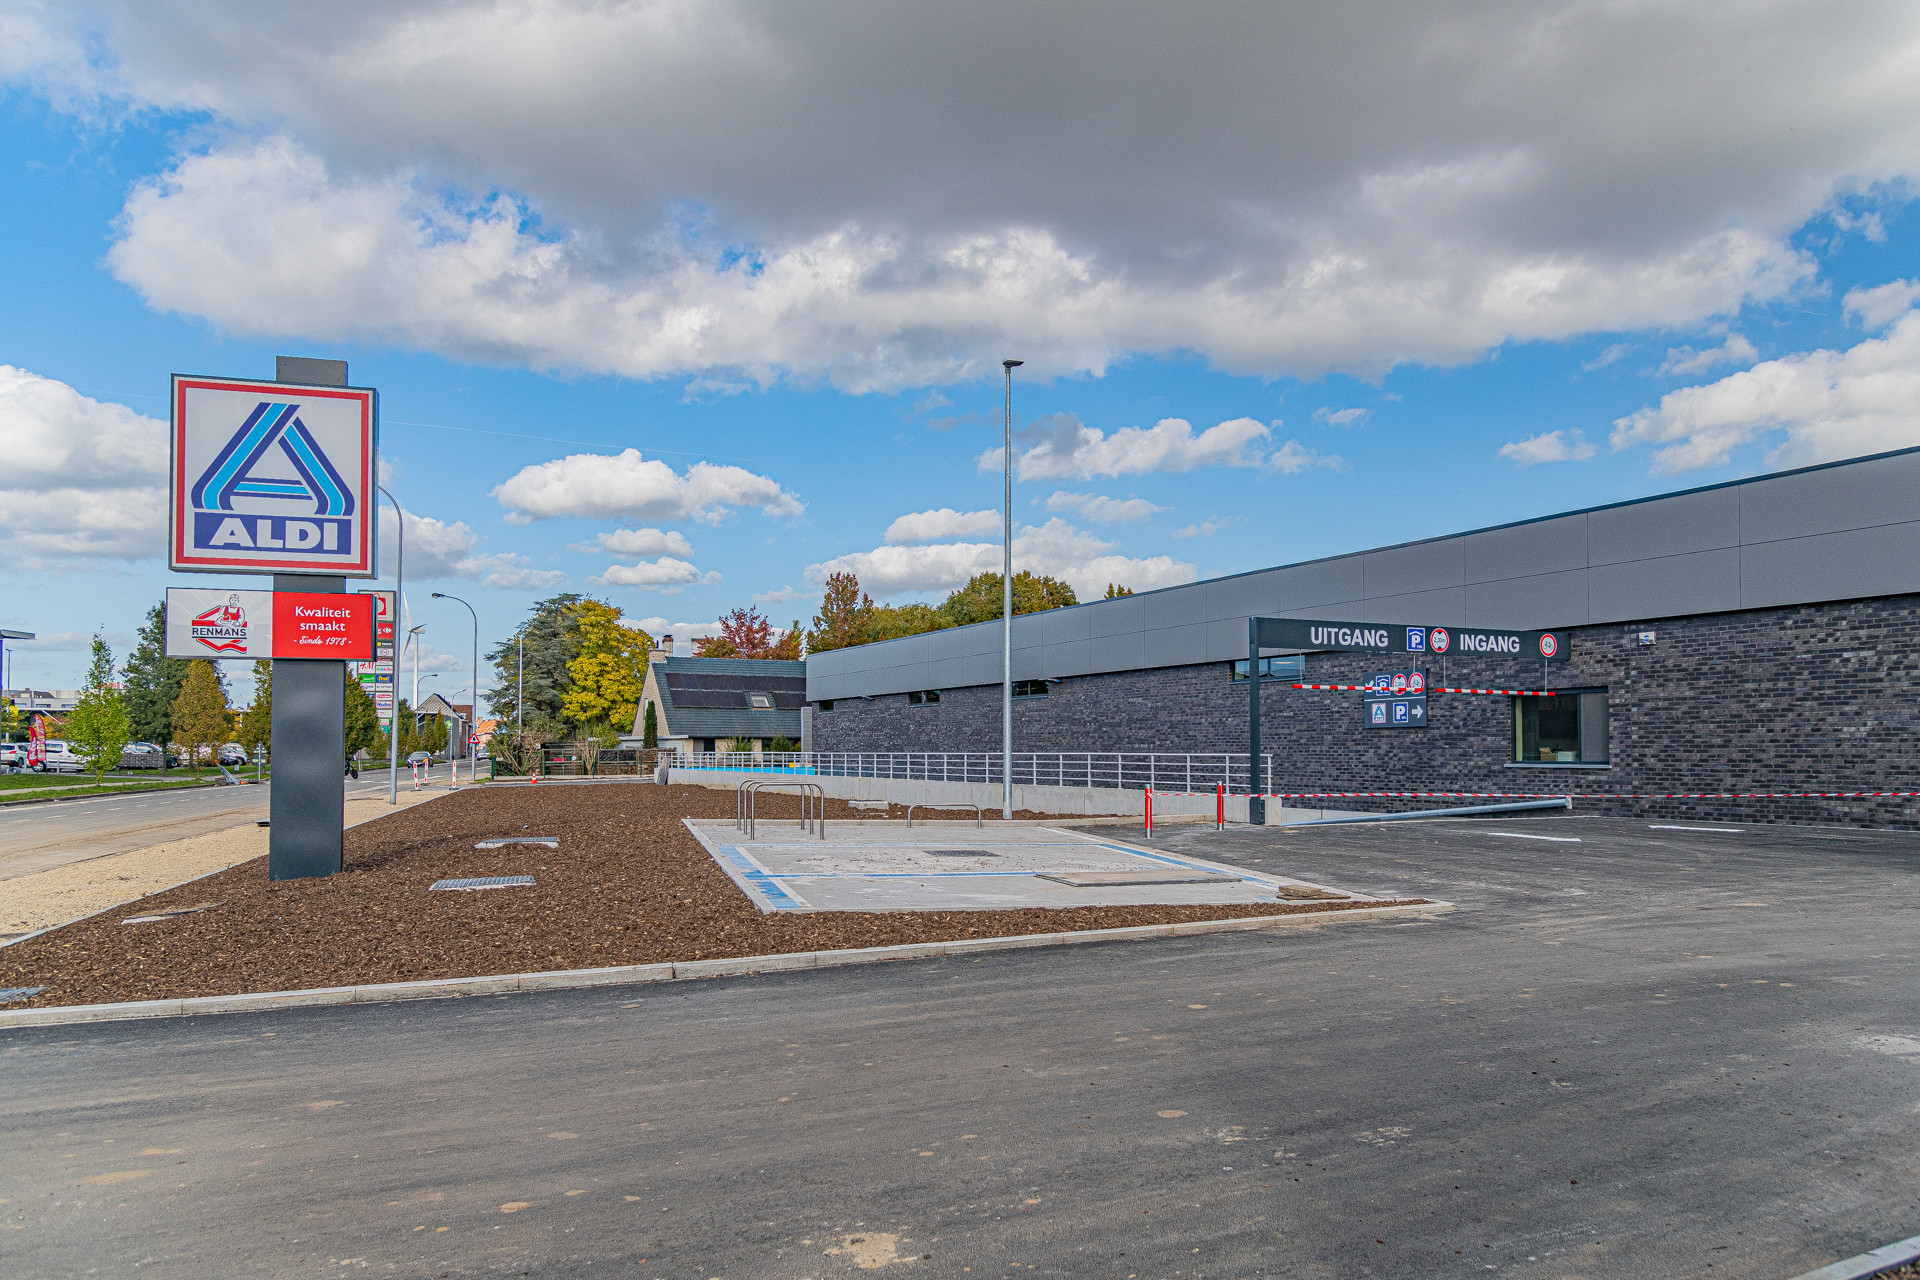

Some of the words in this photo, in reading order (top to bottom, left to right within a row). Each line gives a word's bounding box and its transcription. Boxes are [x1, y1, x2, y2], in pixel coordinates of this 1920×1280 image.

[208, 517, 338, 551] ALDI
[295, 606, 351, 618] Kwaliteit
[192, 627, 247, 637] RENMANS
[300, 620, 346, 631] smaakt
[299, 635, 323, 645] Sinds
[325, 636, 347, 645] 1978
[1310, 626, 1389, 647] UITGANG
[1411, 635, 1421, 648] P
[1460, 634, 1520, 653] INGANG
[1396, 706, 1406, 720] P
